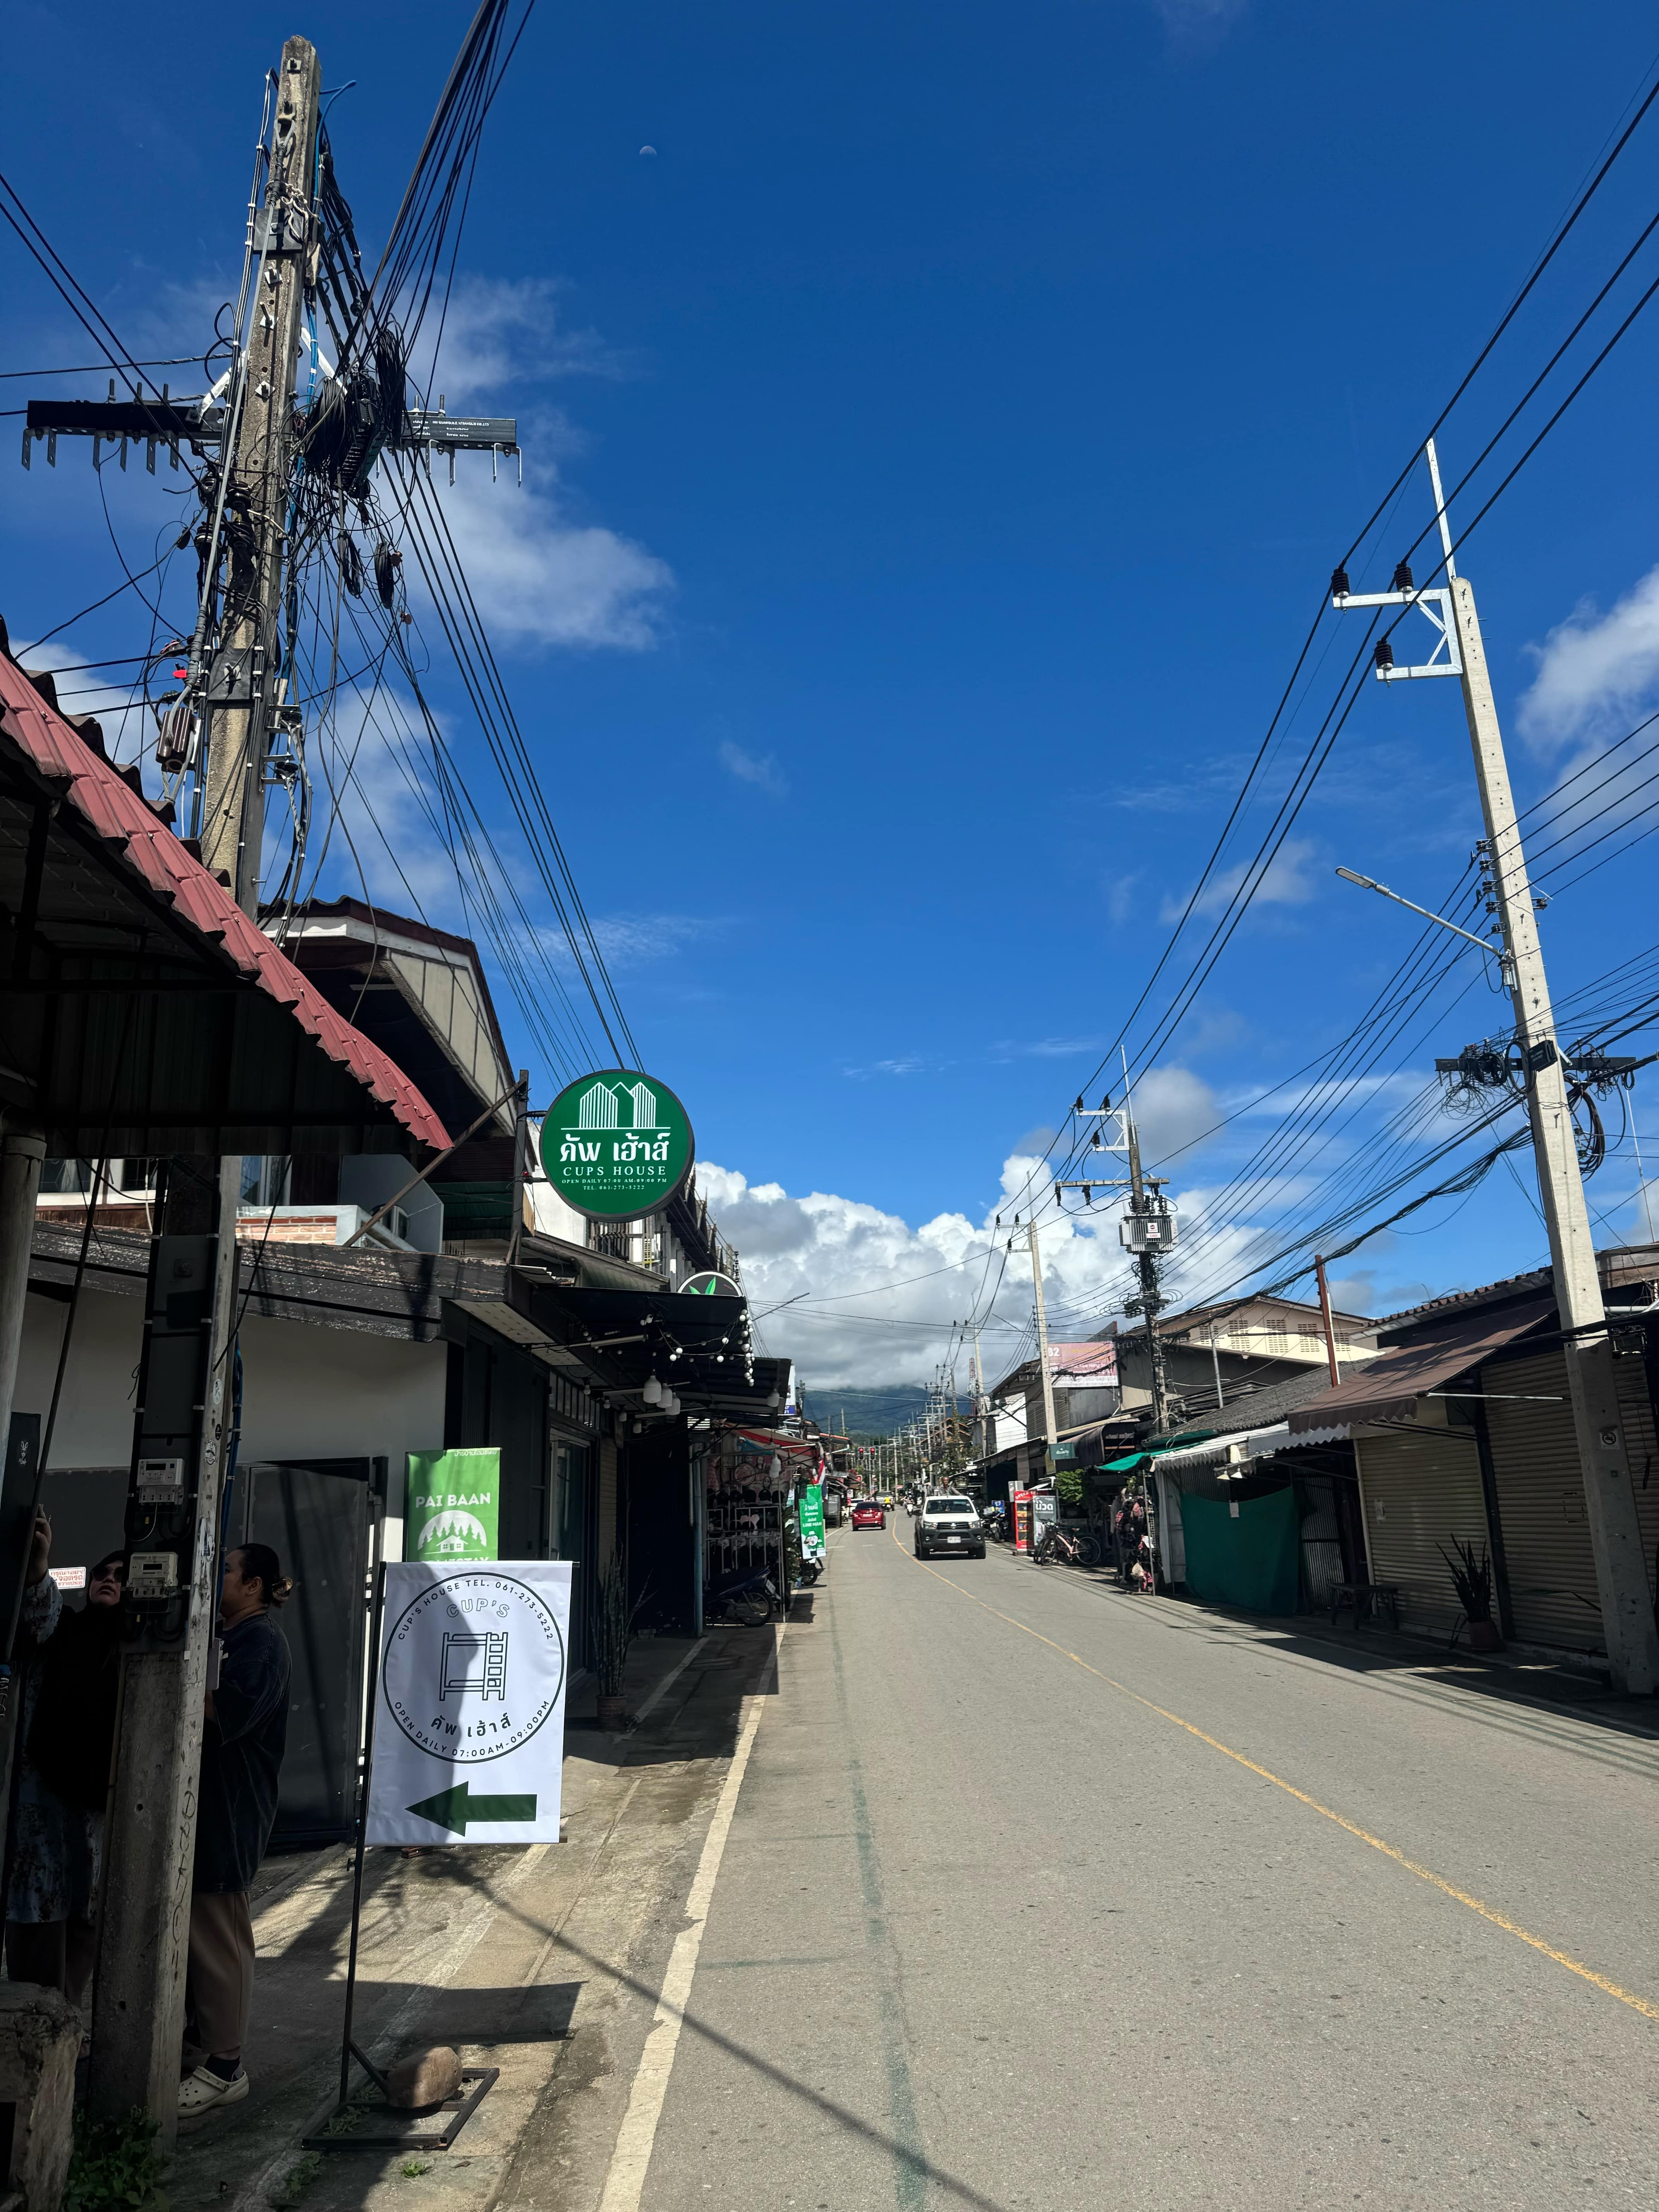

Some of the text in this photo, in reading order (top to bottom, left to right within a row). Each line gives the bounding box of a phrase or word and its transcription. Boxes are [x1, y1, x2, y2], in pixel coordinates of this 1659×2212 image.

[560, 1133, 670, 1161] คัพ เฮ้าส์
[563, 1166, 665, 1176] CUPS HOUSE
[416, 1492, 490, 1508] PAI BAAN
[398, 1607, 421, 1640] CUP'S
[424, 1583, 460, 1606] HOUSE
[496, 1582, 553, 1640] 061-273-5222
[395, 1701, 549, 1757] OPEN DAILY 07:00AM-09:00PM
[431, 1712, 511, 1737] คัพ เฮ้าส์
